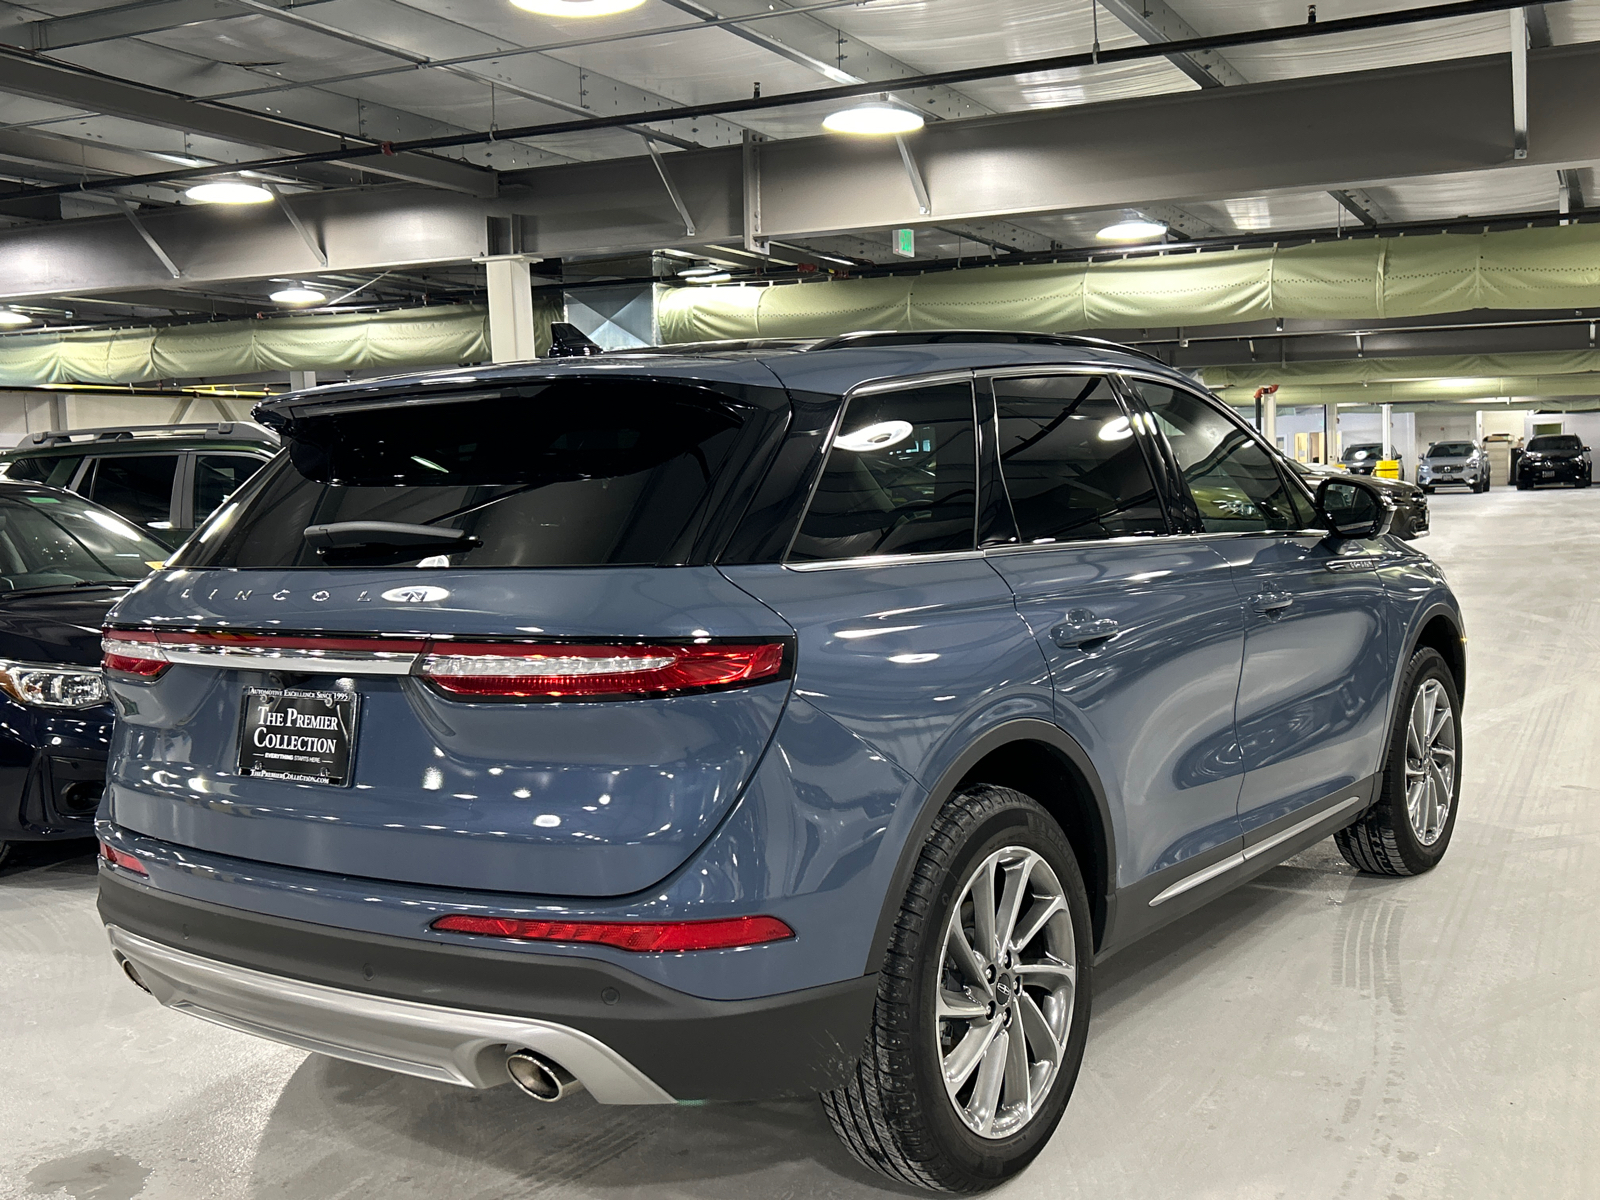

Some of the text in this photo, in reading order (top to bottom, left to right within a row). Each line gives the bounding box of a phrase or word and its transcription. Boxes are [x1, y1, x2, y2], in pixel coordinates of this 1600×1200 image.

[180, 588, 429, 603] LINCOLN
[334, 691, 349, 700] 1995
[258, 707, 338, 730] THE PREMIER
[254, 727, 336, 753] COLLECTION
